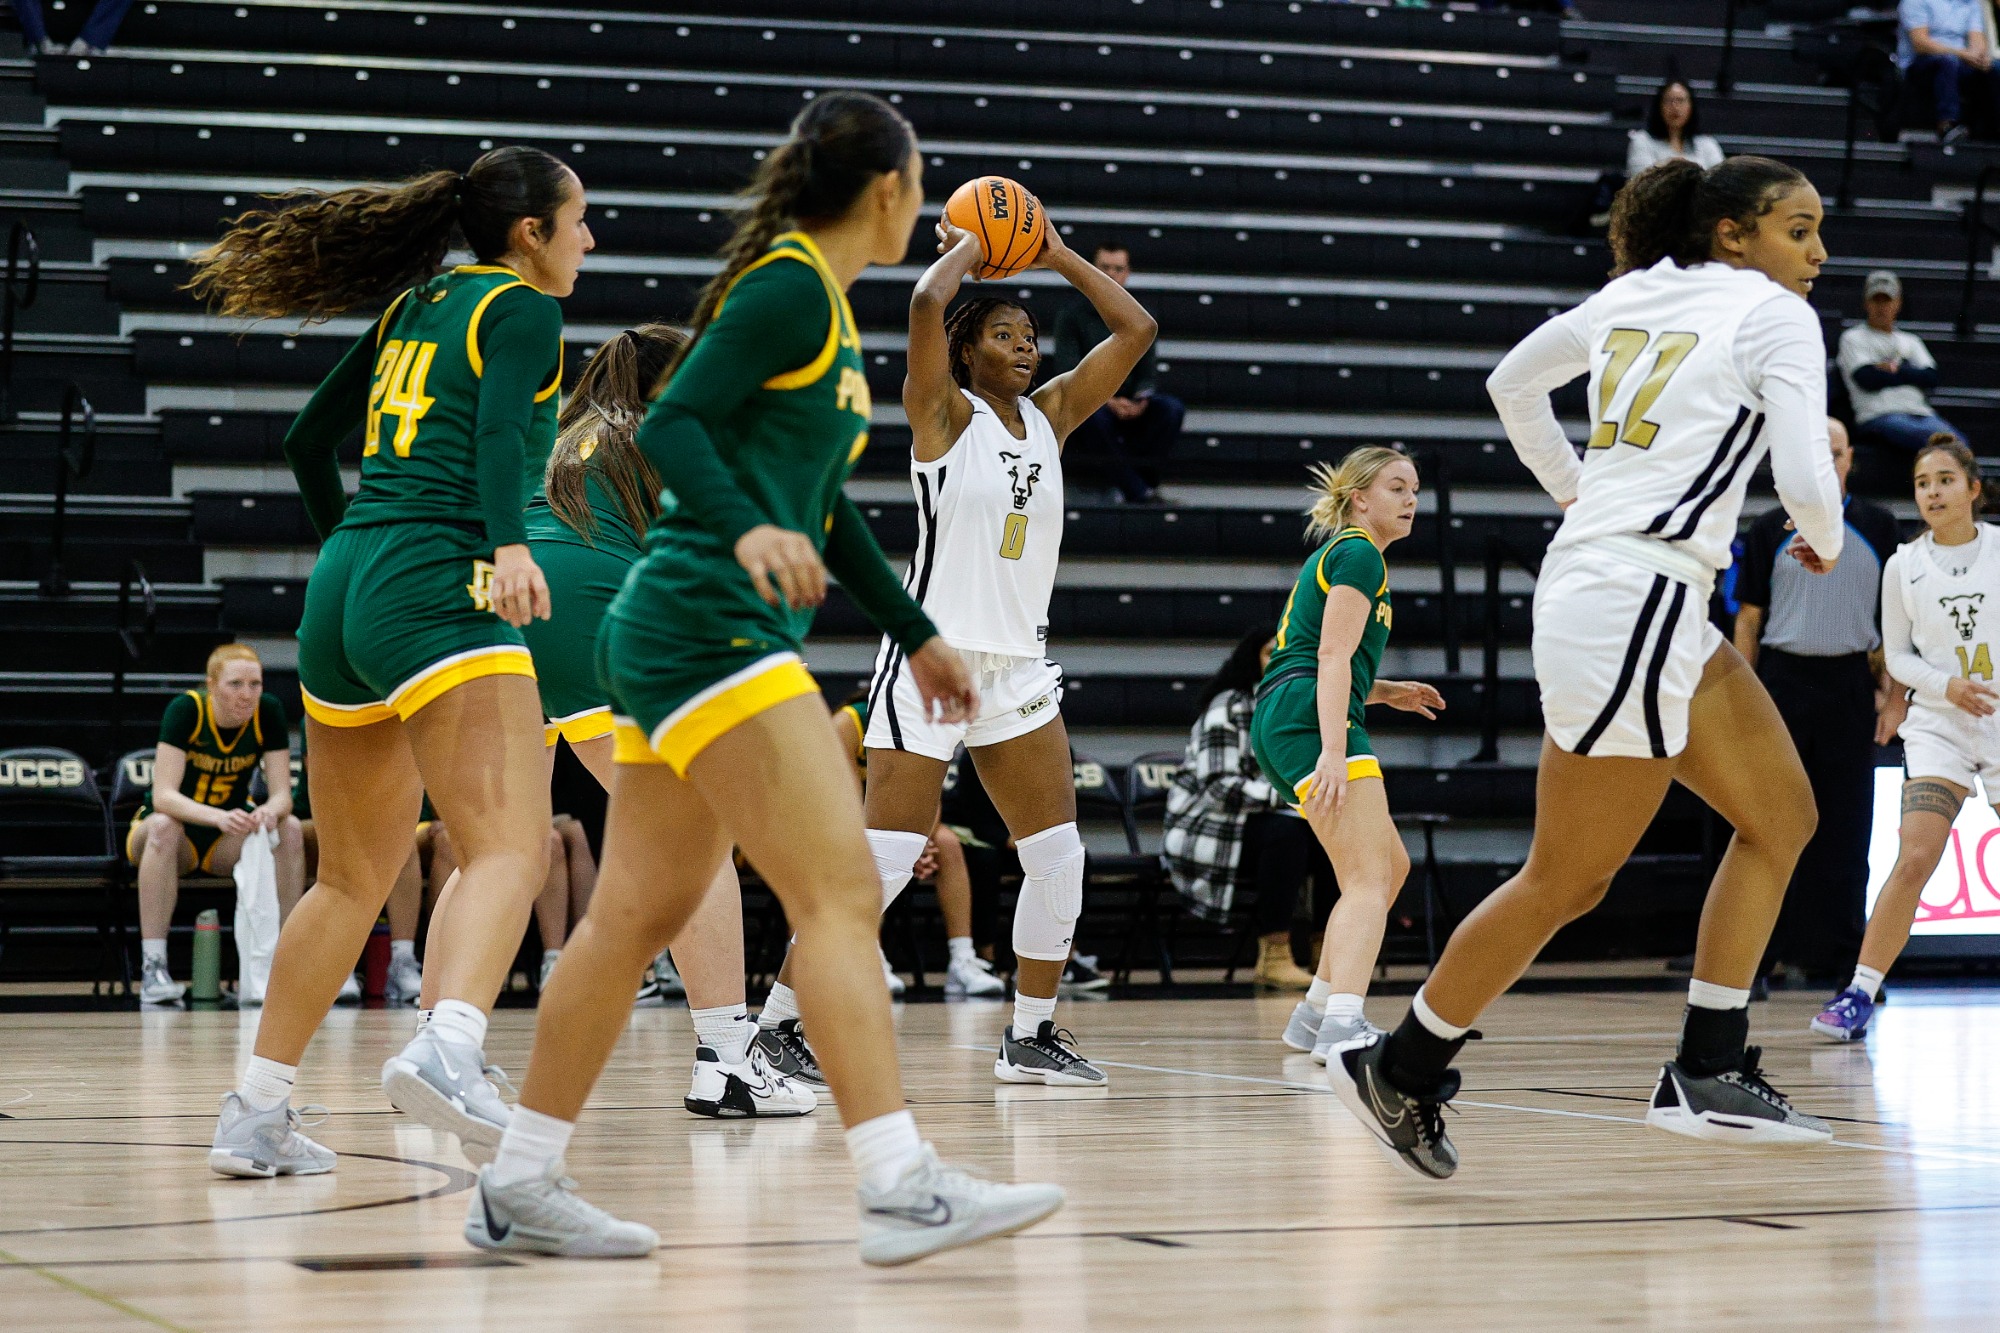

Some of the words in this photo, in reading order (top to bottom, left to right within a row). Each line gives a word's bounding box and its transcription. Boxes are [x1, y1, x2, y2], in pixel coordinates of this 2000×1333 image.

[989, 180, 1008, 219] NCAA
[363, 339, 437, 458] 24
[1588, 327, 1699, 450] 22
[1000, 513, 1028, 560] 0
[1955, 643, 1993, 680] 14
[1016, 694, 1050, 718] UCCS
[0, 759, 84, 786] UCCS
[194, 772, 239, 805] 15
[1137, 763, 1175, 788] UC
